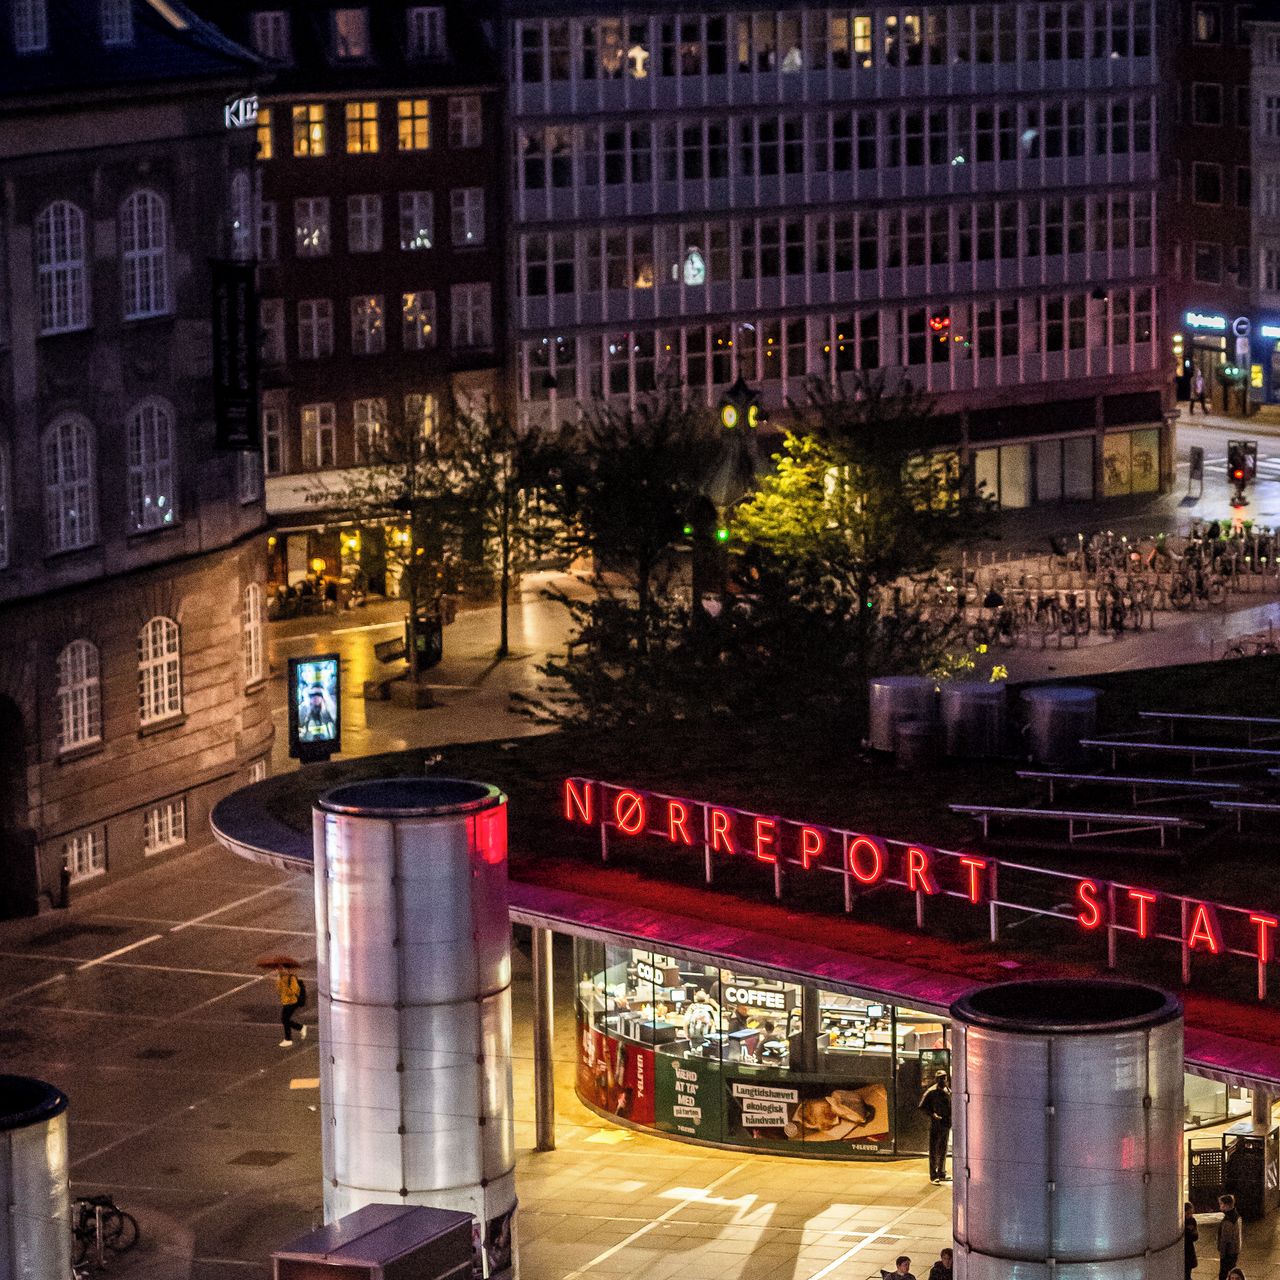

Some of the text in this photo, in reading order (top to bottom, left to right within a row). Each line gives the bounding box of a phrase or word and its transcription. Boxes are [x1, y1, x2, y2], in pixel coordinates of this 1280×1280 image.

[564, 778, 987, 904] NØRREPORT
[637, 962, 664, 985] COLD
[725, 987, 786, 1009] COFFEE
[675, 1081, 684, 1092] AT
[736, 1085, 794, 1100] Langtidshævet
[678, 1094, 695, 1106] MED
[746, 1102, 784, 1114] økologisk
[745, 1115, 785, 1125] håndværk
